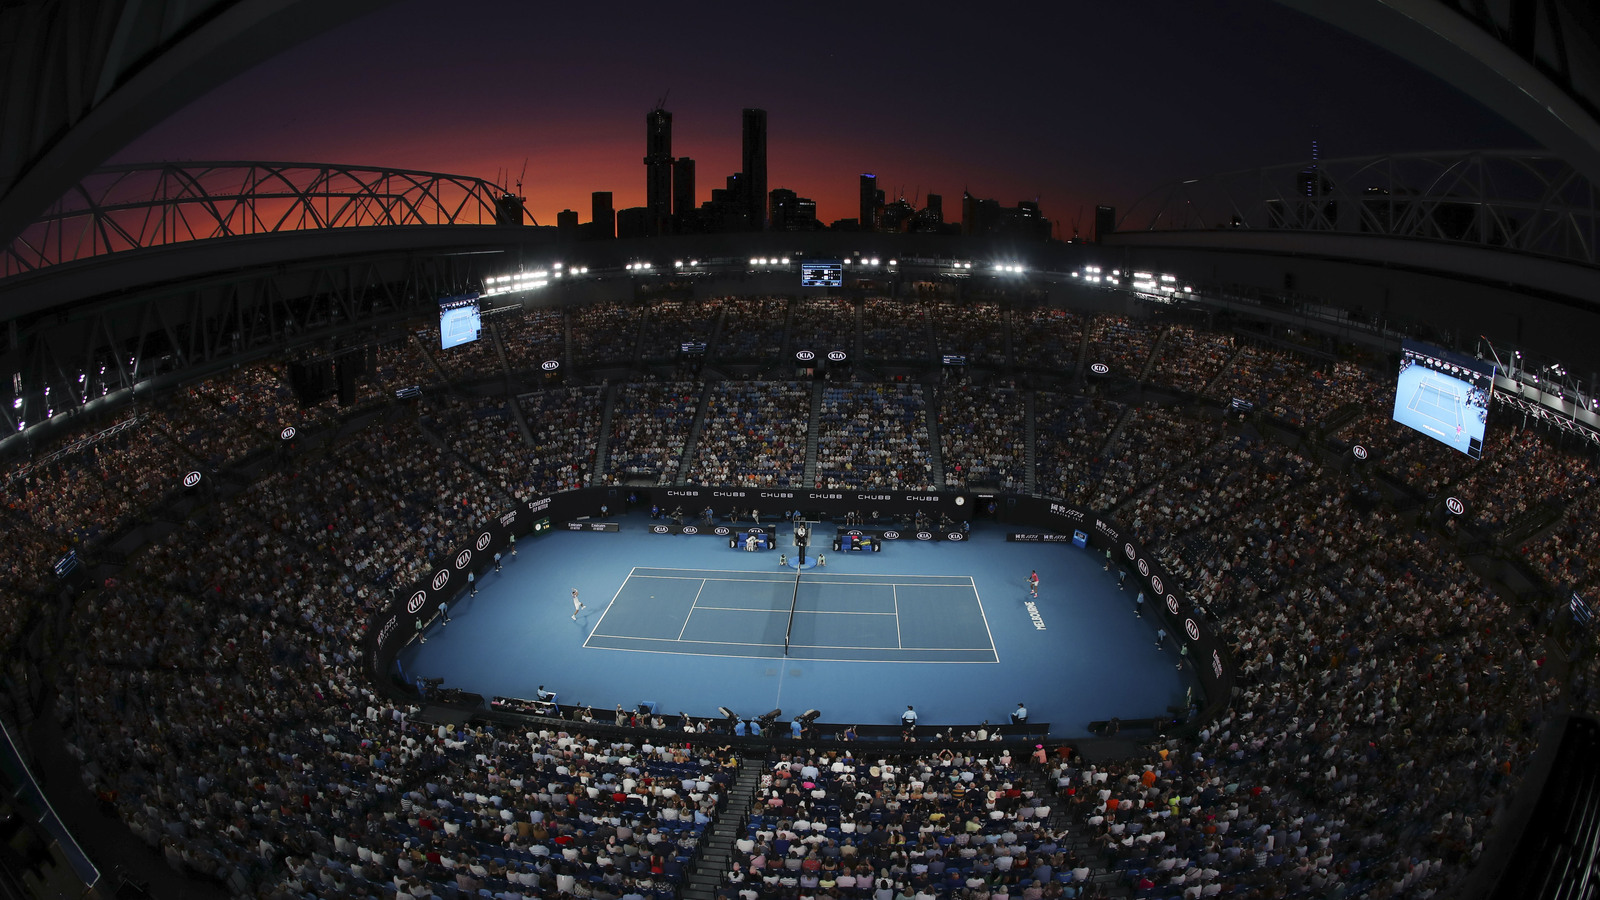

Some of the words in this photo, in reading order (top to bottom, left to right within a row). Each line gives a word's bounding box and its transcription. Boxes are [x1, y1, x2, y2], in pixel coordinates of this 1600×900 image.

[283, 428, 294, 438] KIA
[1354, 447, 1366, 458] KIA
[185, 473, 200, 485] KIA
[1448, 498, 1462, 513] KIA
[478, 534, 490, 549] KIA
[458, 551, 470, 568] KIA
[1139, 560, 1148, 576] KIA
[434, 571, 448, 588] KIA
[1153, 577, 1162, 593] KIA
[409, 592, 425, 610] KIA
[1168, 596, 1178, 613] KIA
[1024, 601, 1046, 630] MELBOURNE
[1187, 620, 1198, 639] KIA
